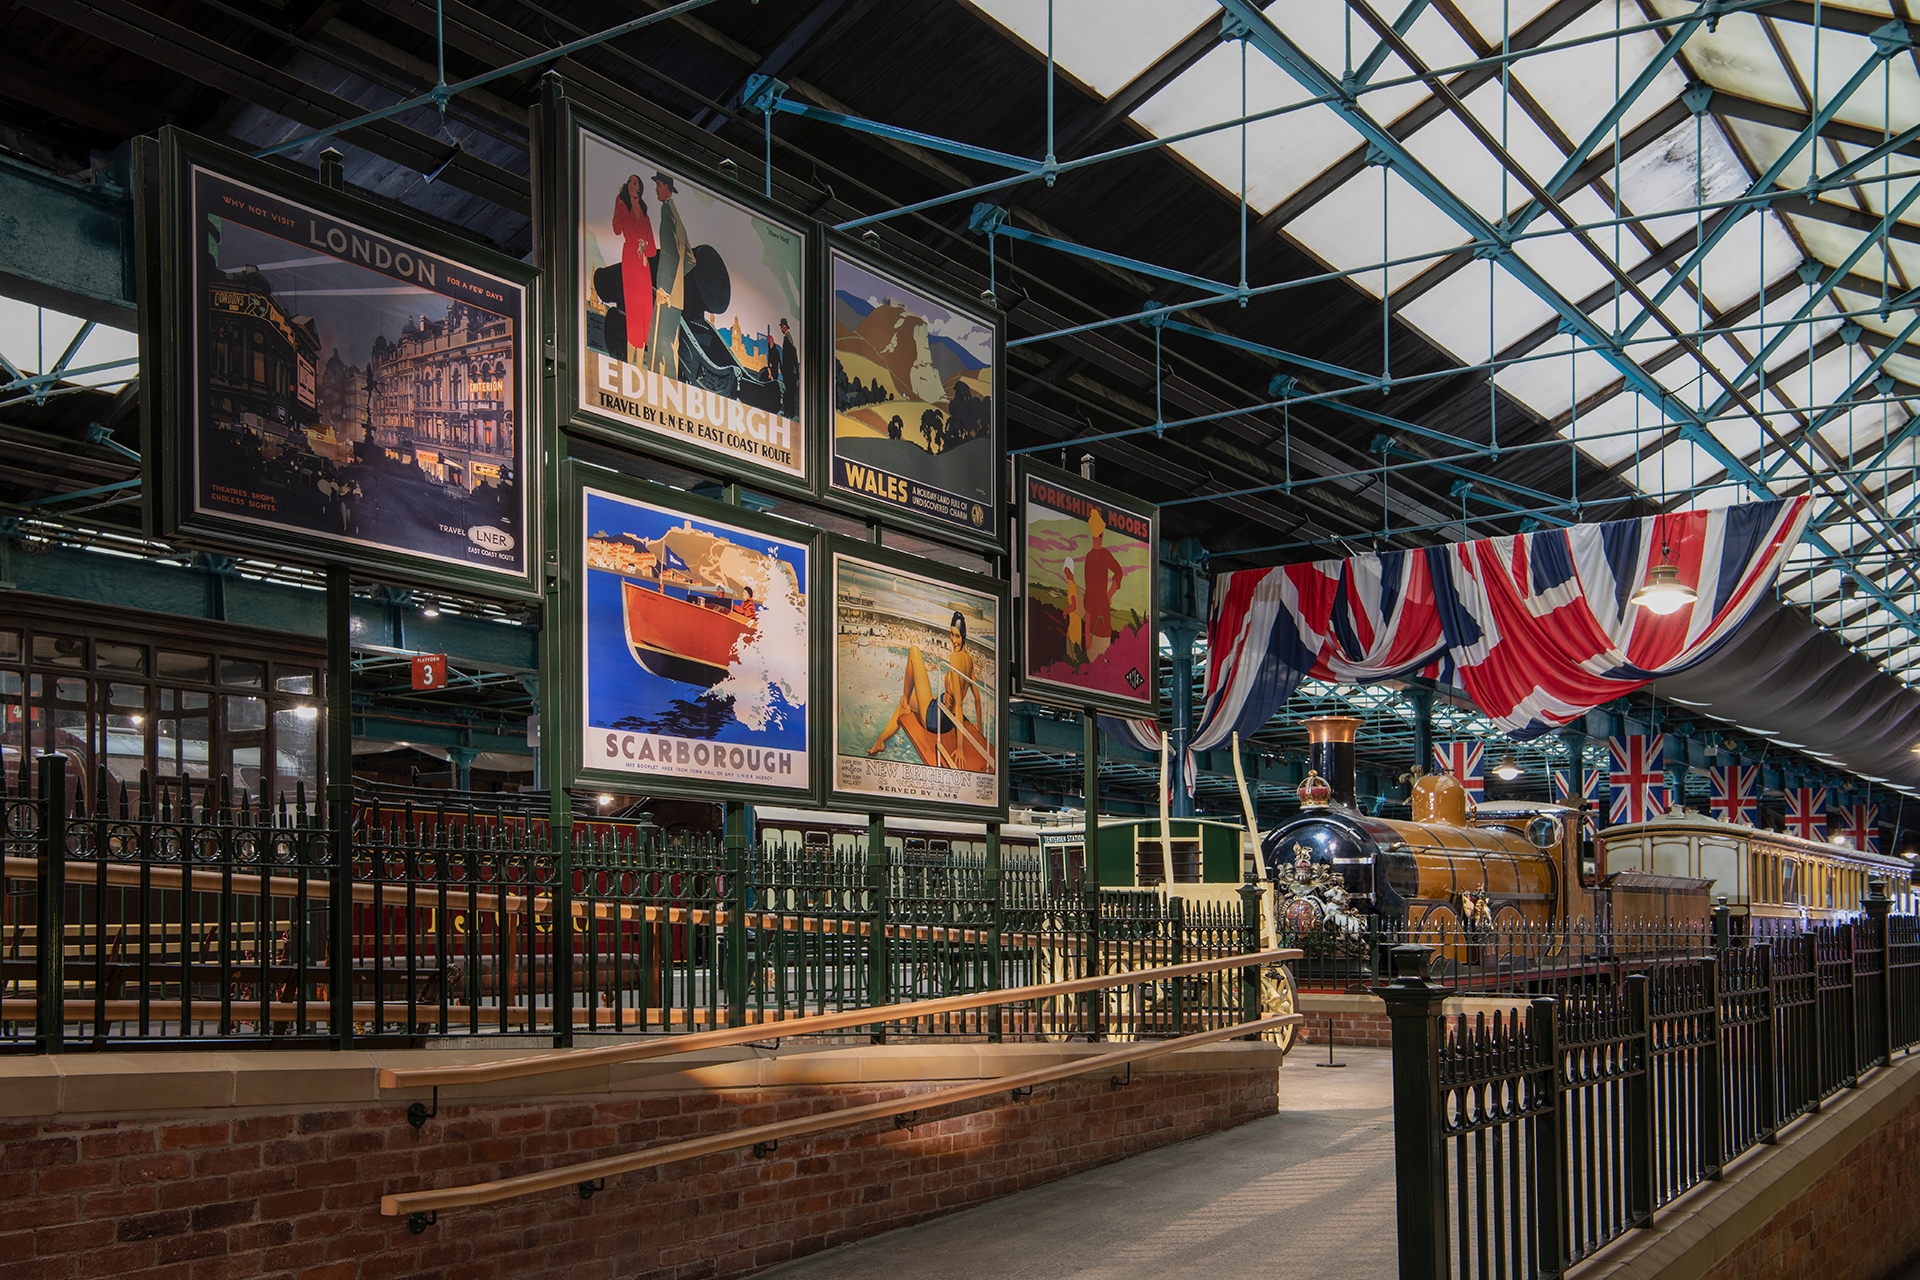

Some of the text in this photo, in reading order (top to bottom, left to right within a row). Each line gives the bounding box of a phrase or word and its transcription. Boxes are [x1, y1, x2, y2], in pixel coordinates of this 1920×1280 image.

[222, 196, 296, 227] WHY NOT VISIT
[310, 219, 436, 287] LONDON
[447, 276, 461, 287] FOR
[469, 284, 484, 295] FEW
[485, 290, 504, 302] DAYS
[598, 353, 790, 449] EDINBURGH
[599, 392, 641, 418] TRAVEL
[644, 407, 656, 422] BY
[698, 425, 723, 443] EAST
[727, 434, 759, 454] COAST
[762, 445, 791, 464] ROUTE
[212, 484, 277, 504] THEATRES. SHOPS.
[845, 462, 908, 503] WALES
[212, 493, 277, 512] ENDLESS SIGHTS.
[912, 487, 916, 495] A
[917, 488, 950, 505] HOLIDAY-LAND
[951, 499, 960, 508] FULL
[912, 496, 948, 514] UNDISCOVERED
[949, 508, 967, 520] CHARM
[439, 524, 507, 546] TRAVEL LNER
[1108, 510, 1148, 538] MOORS
[468, 546, 514, 562] EAST COAST ROUTE
[424, 665, 433, 685] 3
[13, 706, 22, 718] 4
[606, 733, 791, 774] SCARBOROUGH
[866, 760, 972, 787] NEW BRIGHTON
[878, 786, 916, 794] SERVED
[896, 779, 961, 793] WALLASEY
[1067, 834, 1086, 842] STATION
